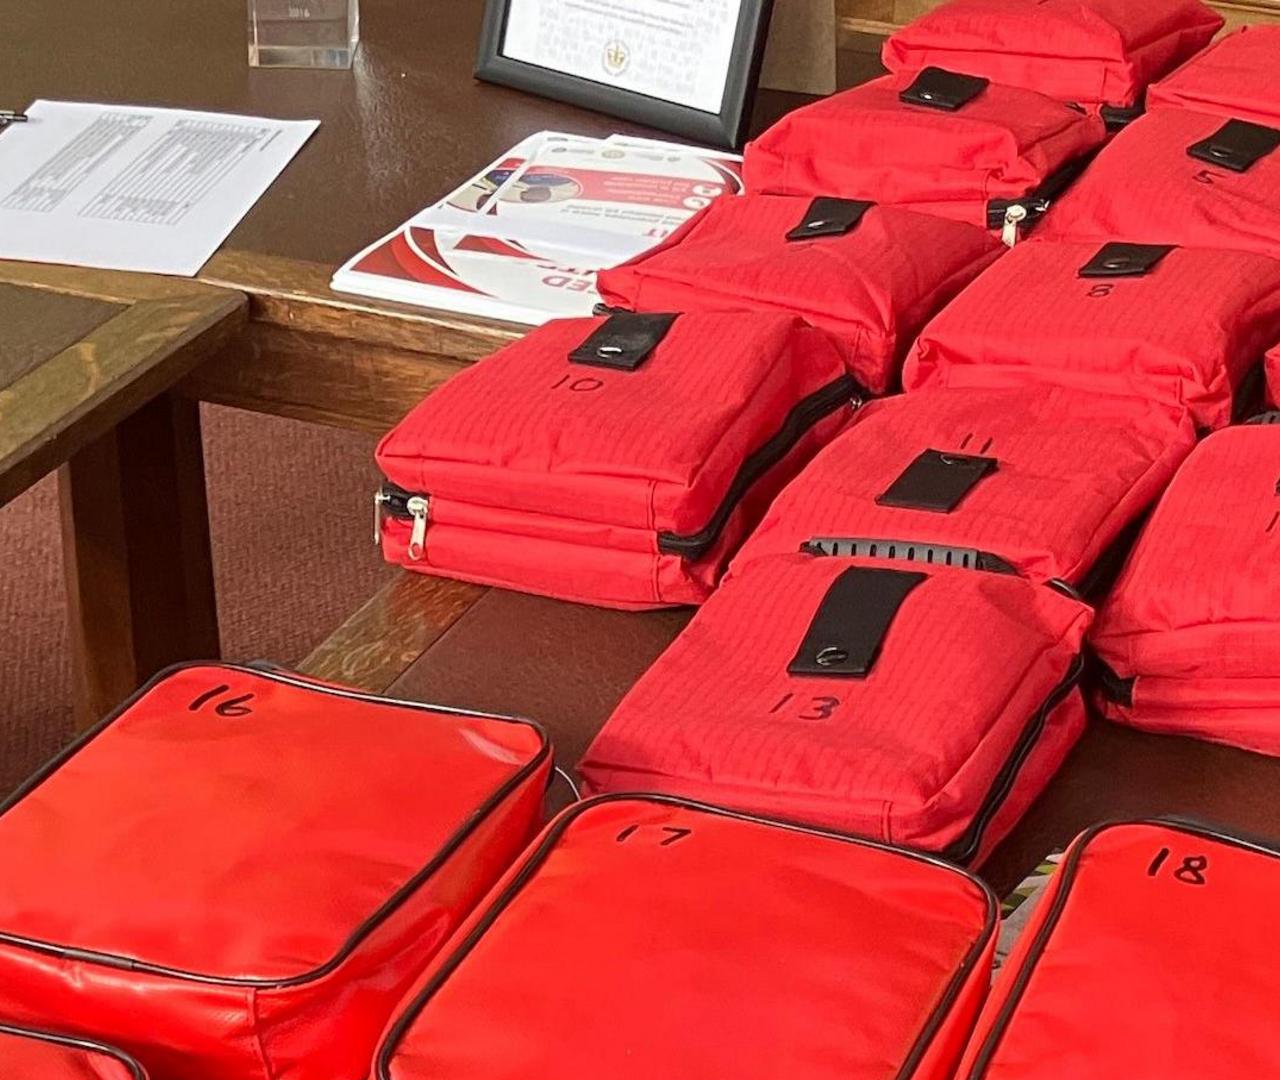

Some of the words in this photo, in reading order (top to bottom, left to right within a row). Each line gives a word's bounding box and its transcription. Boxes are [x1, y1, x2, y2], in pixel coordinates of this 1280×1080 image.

[1086, 283, 1115, 298] 8
[551, 375, 605, 393] 10
[960, 433, 994, 455] 11
[188, 684, 255, 717] 16
[769, 692, 841, 721] 13
[616, 823, 693, 847] 17
[1147, 847, 1208, 885] 18
